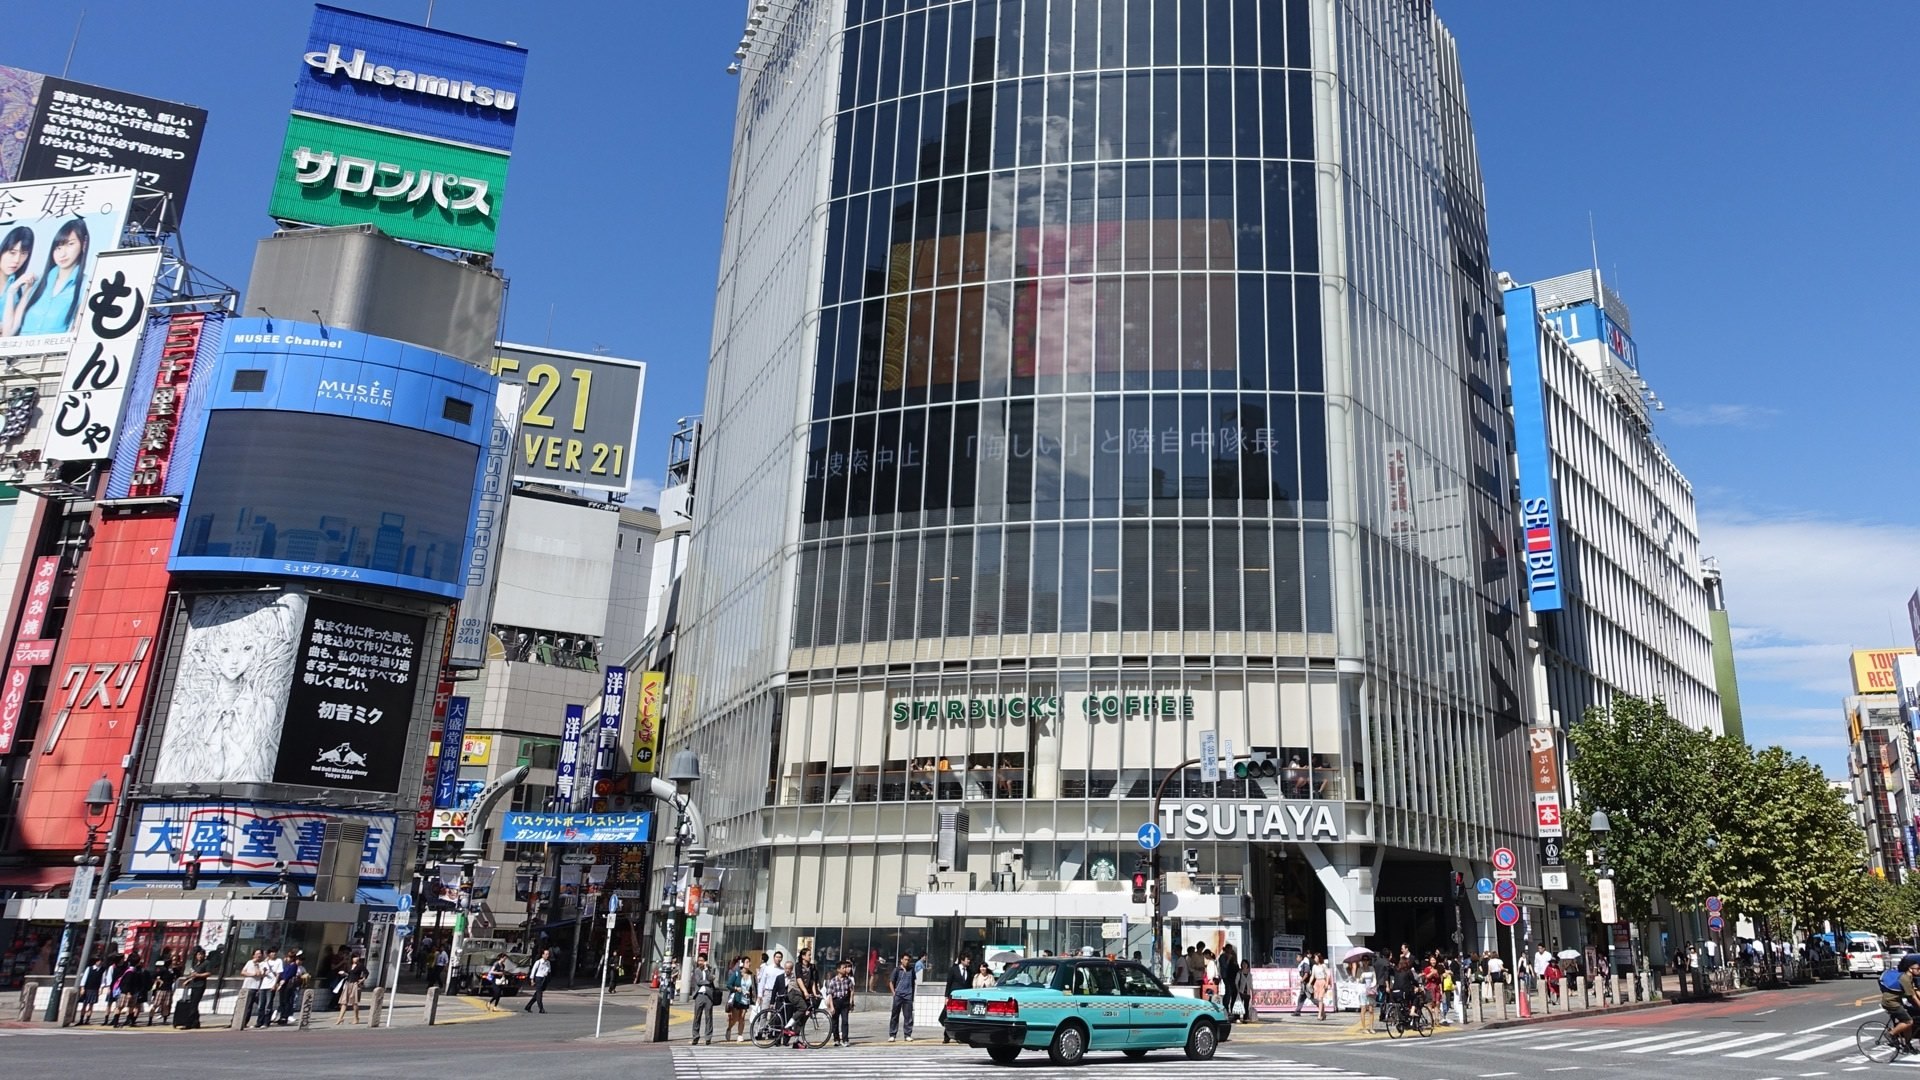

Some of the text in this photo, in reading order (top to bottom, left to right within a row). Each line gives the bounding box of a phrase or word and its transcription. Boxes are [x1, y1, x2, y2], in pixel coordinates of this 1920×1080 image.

[303, 43, 516, 111] Hisamitsu
[46, 112, 123, 137] でもやめない。
[39, 135, 113, 158] けられるから。
[292, 146, 490, 216] サロンパス
[234, 335, 342, 349] MUSEE Channel
[55, 270, 145, 454] もんじゃ
[131, 318, 200, 486] 三千里薬品
[317, 391, 392, 407] PLATINUM
[590, 443, 623, 475] 21
[467, 510, 495, 587] neon
[1524, 497, 1556, 594] SEIBU
[283, 563, 360, 579] ミュゼプラチナム
[23, 561, 54, 635] お好み焼
[313, 618, 414, 645] 気まぐれに作った歌も、
[459, 628, 480, 636] 3719
[462, 618, 481, 628] (03)
[311, 632, 413, 658] 魂を込めて作りこんだ
[457, 636, 479, 645] 2468
[306, 659, 408, 684] ぎるデータはすべてが
[308, 645, 410, 672] 曲も、私の中を通り過
[43, 637, 152, 753] クスリ
[303, 672, 369, 692] 等しく愛しい。
[318, 701, 383, 725] 初音ミク
[596, 672, 623, 770] 洋服の青山
[893, 695, 1194, 722] STARBUCKS COFFEE
[435, 704, 464, 800] 大盛堂商事ビル
[638, 750, 651, 760] 4F
[1898, 723, 1917, 780] KARAOKE
[512, 815, 643, 827] バスケットボールストリート
[1159, 804, 1338, 837] TSUTAYA
[1541, 806, 1557, 824] 本
